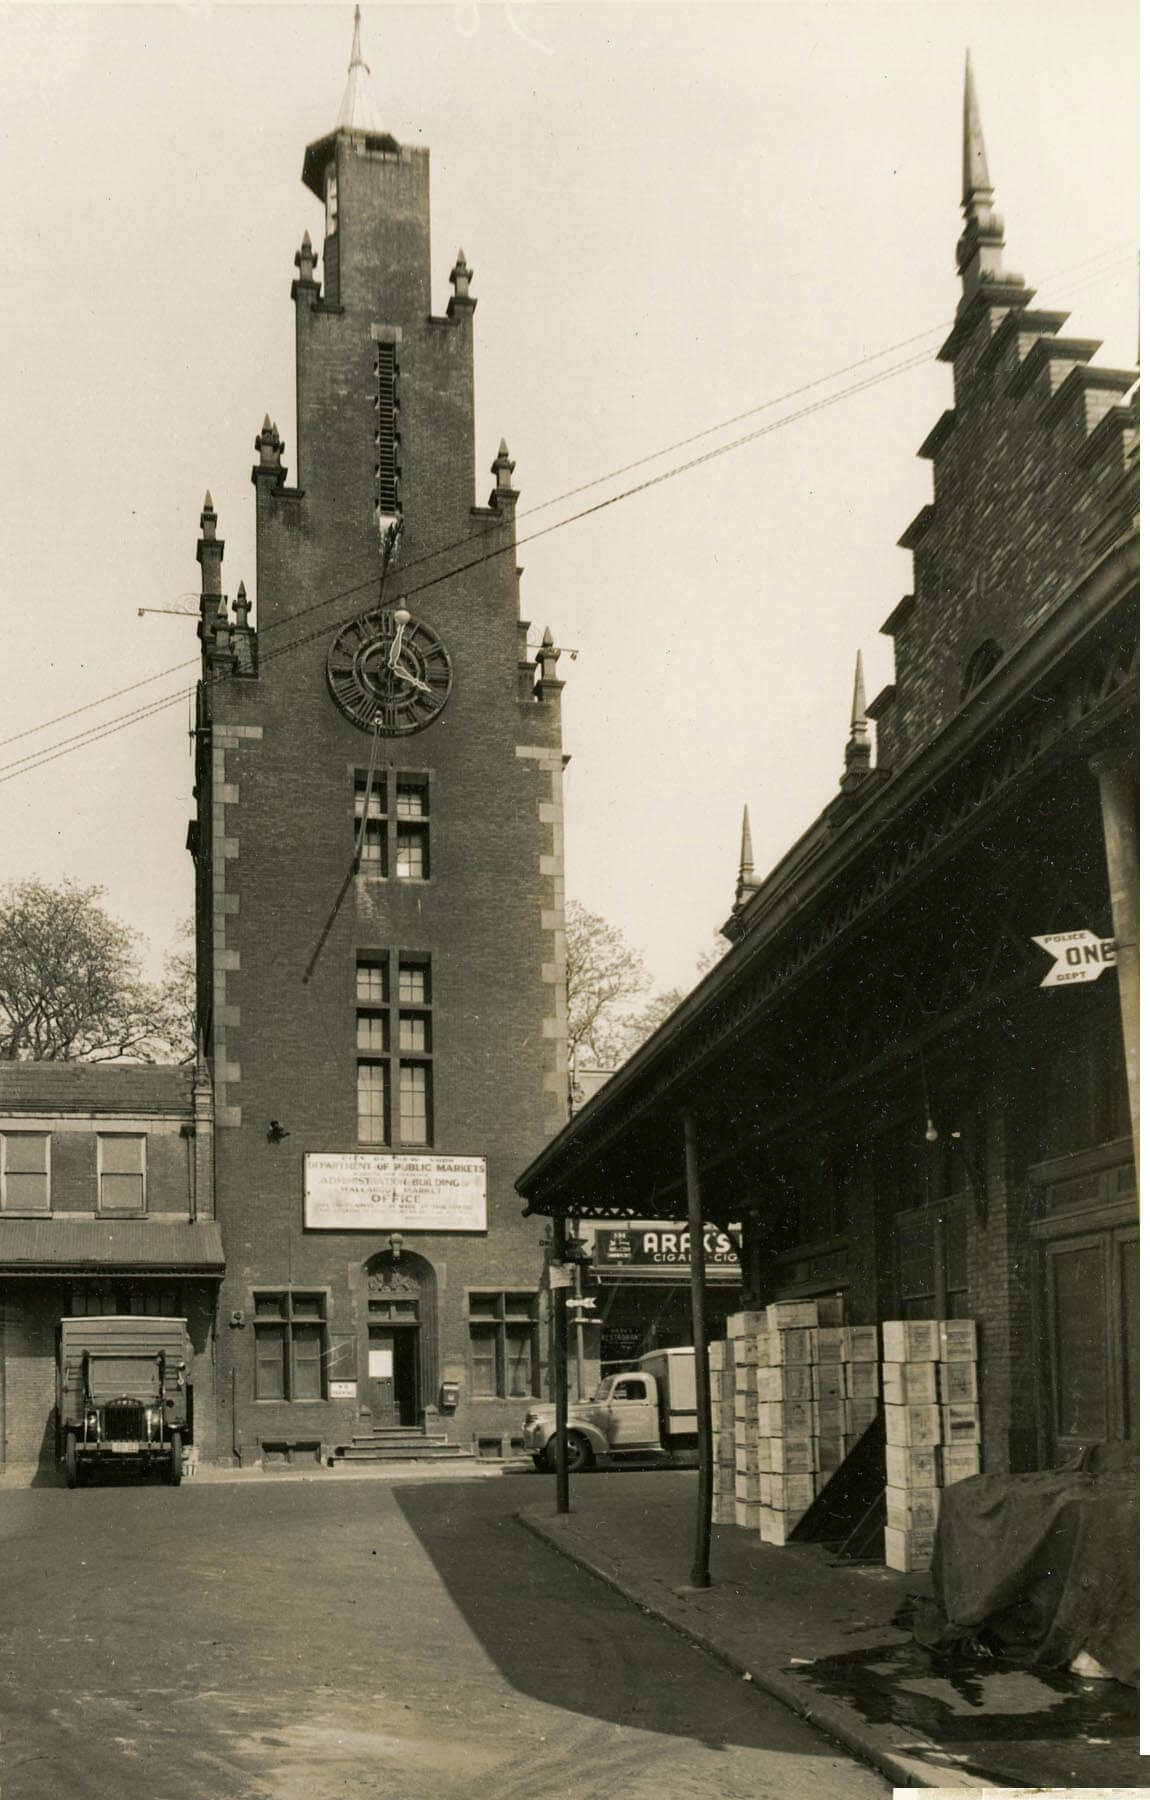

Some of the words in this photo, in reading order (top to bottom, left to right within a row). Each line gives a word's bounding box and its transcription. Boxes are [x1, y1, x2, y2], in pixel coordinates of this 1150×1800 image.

[1043, 932, 1087, 944] POLICE
[1056, 971, 1087, 982] DEPT
[394, 1163, 432, 1173] PUBLIC
[436, 1164, 485, 1174] MARKETS
[371, 1194, 422, 1204] OFFICE
